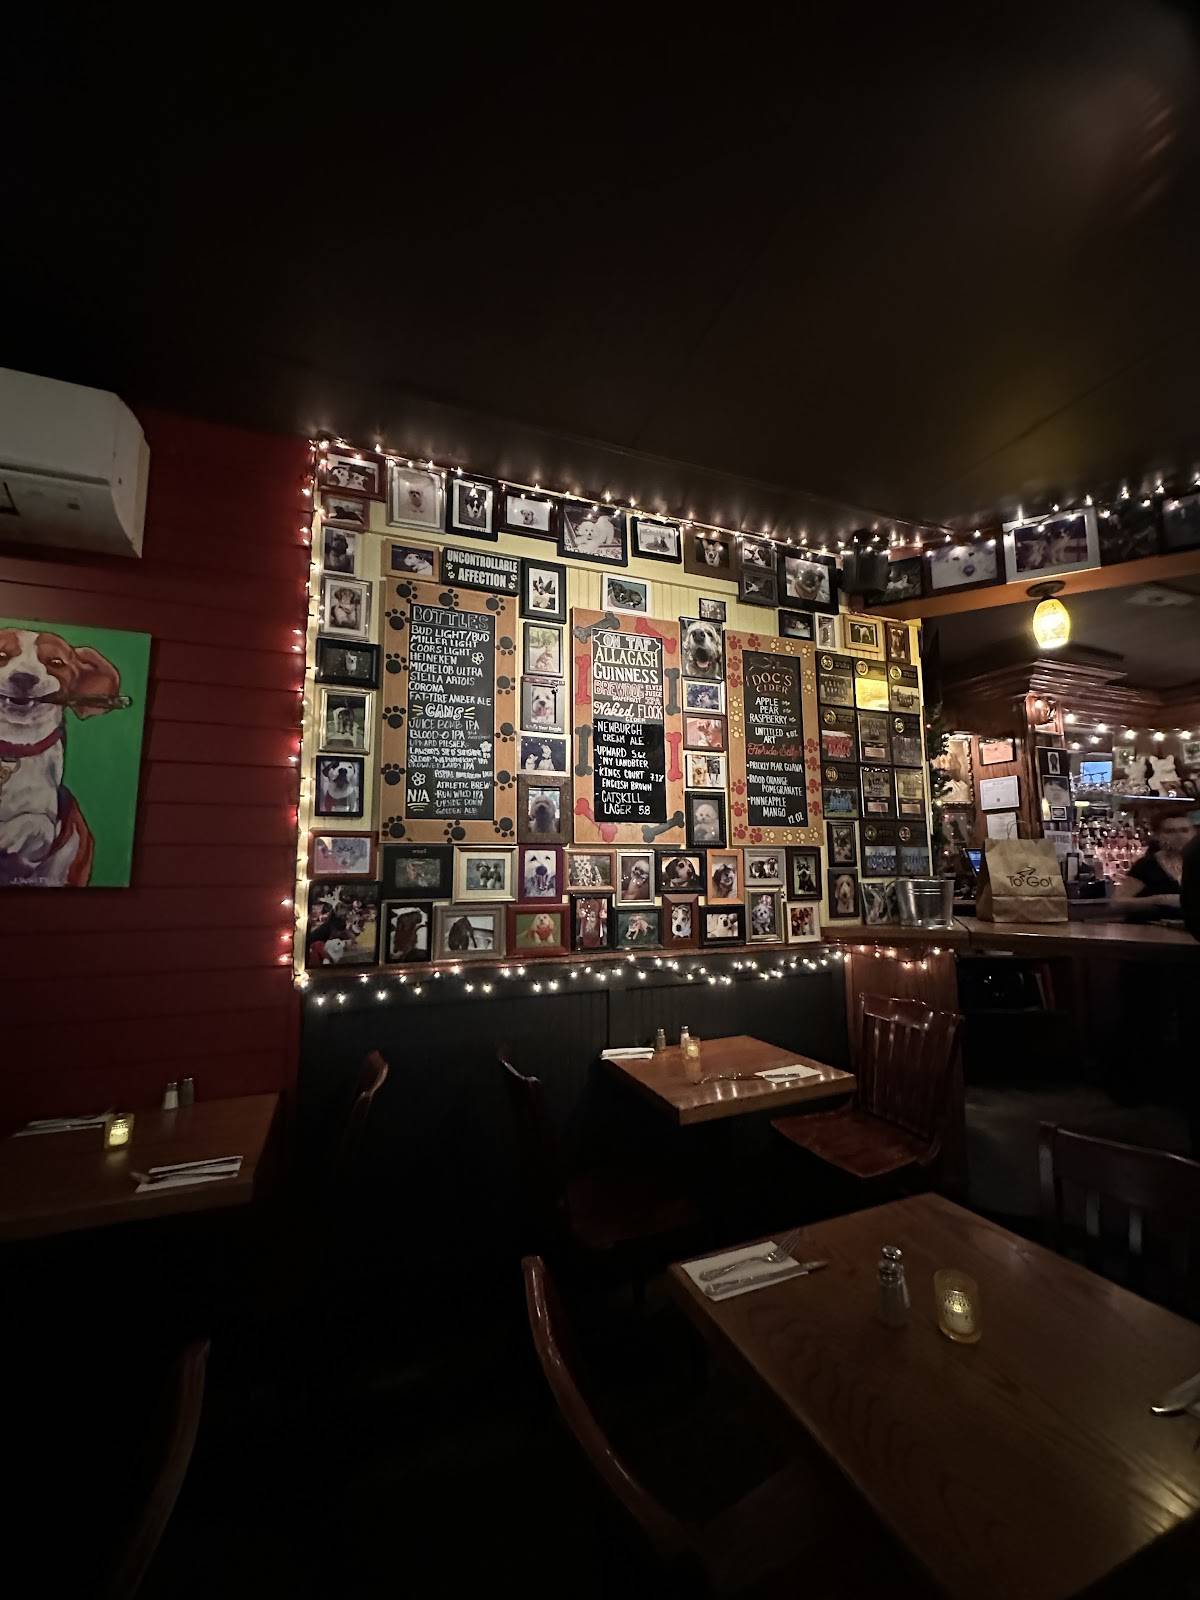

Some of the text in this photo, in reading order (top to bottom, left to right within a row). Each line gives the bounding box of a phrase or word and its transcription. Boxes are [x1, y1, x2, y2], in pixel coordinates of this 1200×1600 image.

[447, 550, 518, 573] UNCONTROLLABLE
[458, 568, 506, 587] AFFECTION
[413, 606, 489, 631] BOTTLES
[411, 625, 433, 636] BUD
[411, 635, 479, 648] MILLER LIGHT
[603, 633, 652, 651] ON TAP
[410, 643, 472, 656] COORS LIGHT
[410, 652, 457, 665] HEINEKEN
[594, 646, 658, 668] ALLAGASH
[410, 662, 483, 678] MICHELOB ULTRA
[593, 662, 659, 684] GUINNESS
[410, 672, 475, 686] STELLA ARTOIS
[751, 672, 793, 687] DOC'S
[409, 681, 445, 693] CORONA
[593, 679, 645, 699] BREWDOG
[756, 684, 788, 694] CIDER
[410, 691, 492, 706] FAT-TIRE AMBER ALE
[755, 697, 779, 706] APPLE
[425, 703, 464, 720] CANS
[593, 700, 664, 719] Naked FLOCK
[760, 705, 780, 715] PEAR
[409, 717, 480, 730] JUICE BOMB IPA
[749, 713, 788, 725] RASPBERRY
[597, 720, 642, 735] NEWBURGH
[755, 727, 784, 737] UNTITLED
[452, 730, 465, 740] IPA
[602, 734, 645, 745] CREAM ALE
[763, 736, 776, 744] ART
[596, 744, 627, 758] UPWARD
[602, 757, 649, 768] NY LANDBIER
[749, 761, 770, 771] PRICKLY
[770, 762, 784, 771] PEAR
[599, 766, 621, 779] KINGS
[623, 769, 645, 780] COURT
[436, 781, 490, 790] ATHLETIC BREW
[602, 778, 653, 792] ENGLISH BROWN
[766, 775, 788, 785] ORANGE
[407, 788, 430, 803] N/A
[453, 791, 472, 799] WILD
[473, 791, 484, 800] IPA
[601, 790, 644, 804] CATSKILL
[761, 784, 803, 797] POMEGRANATE
[603, 803, 632, 815] LAGER
[763, 806, 786, 818] MANGO
